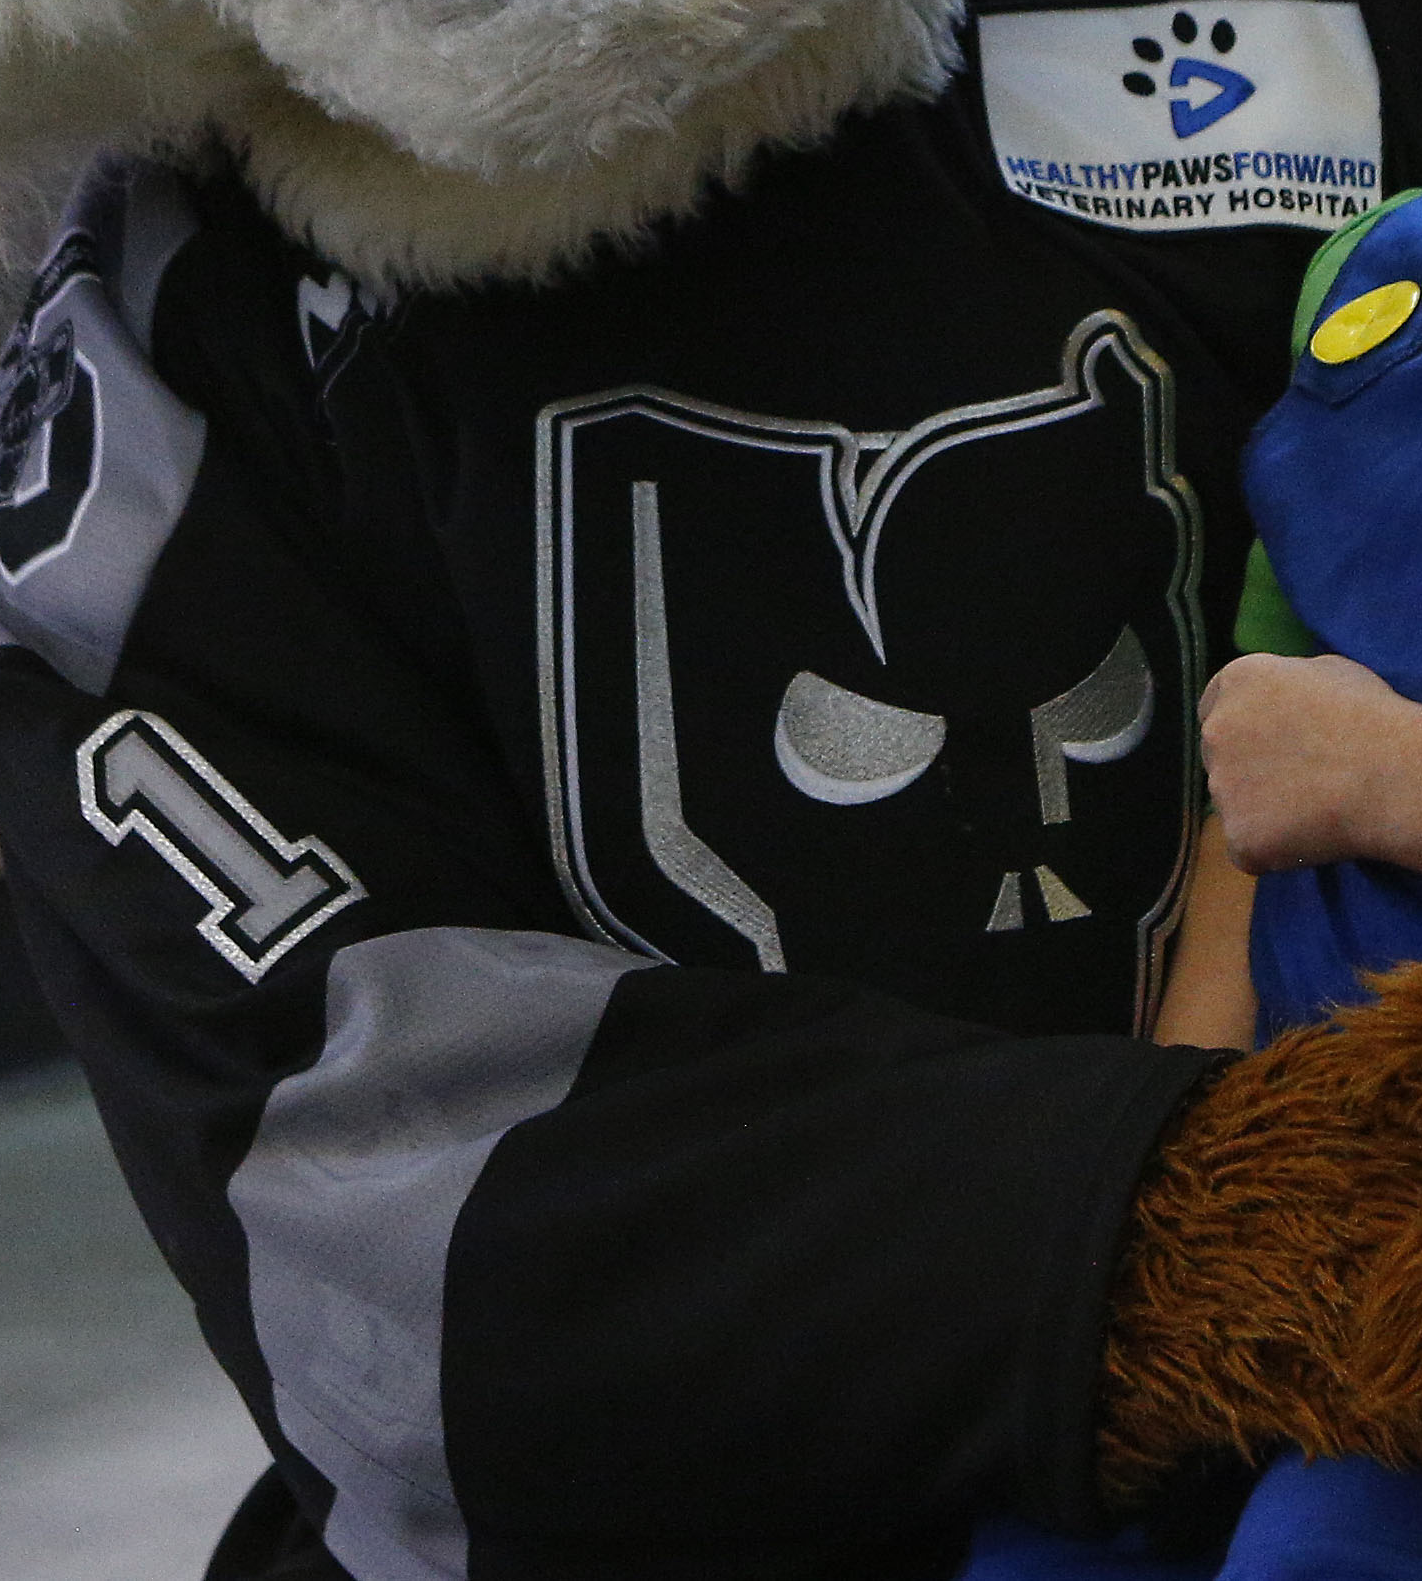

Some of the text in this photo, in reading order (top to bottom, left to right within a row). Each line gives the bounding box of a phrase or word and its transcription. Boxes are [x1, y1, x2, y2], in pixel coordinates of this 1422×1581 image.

[1005, 151, 1375, 191] HEALTHYPAWSFORWARD
[1015, 180, 1215, 218] VETERINARY
[77, 709, 369, 984] 1
